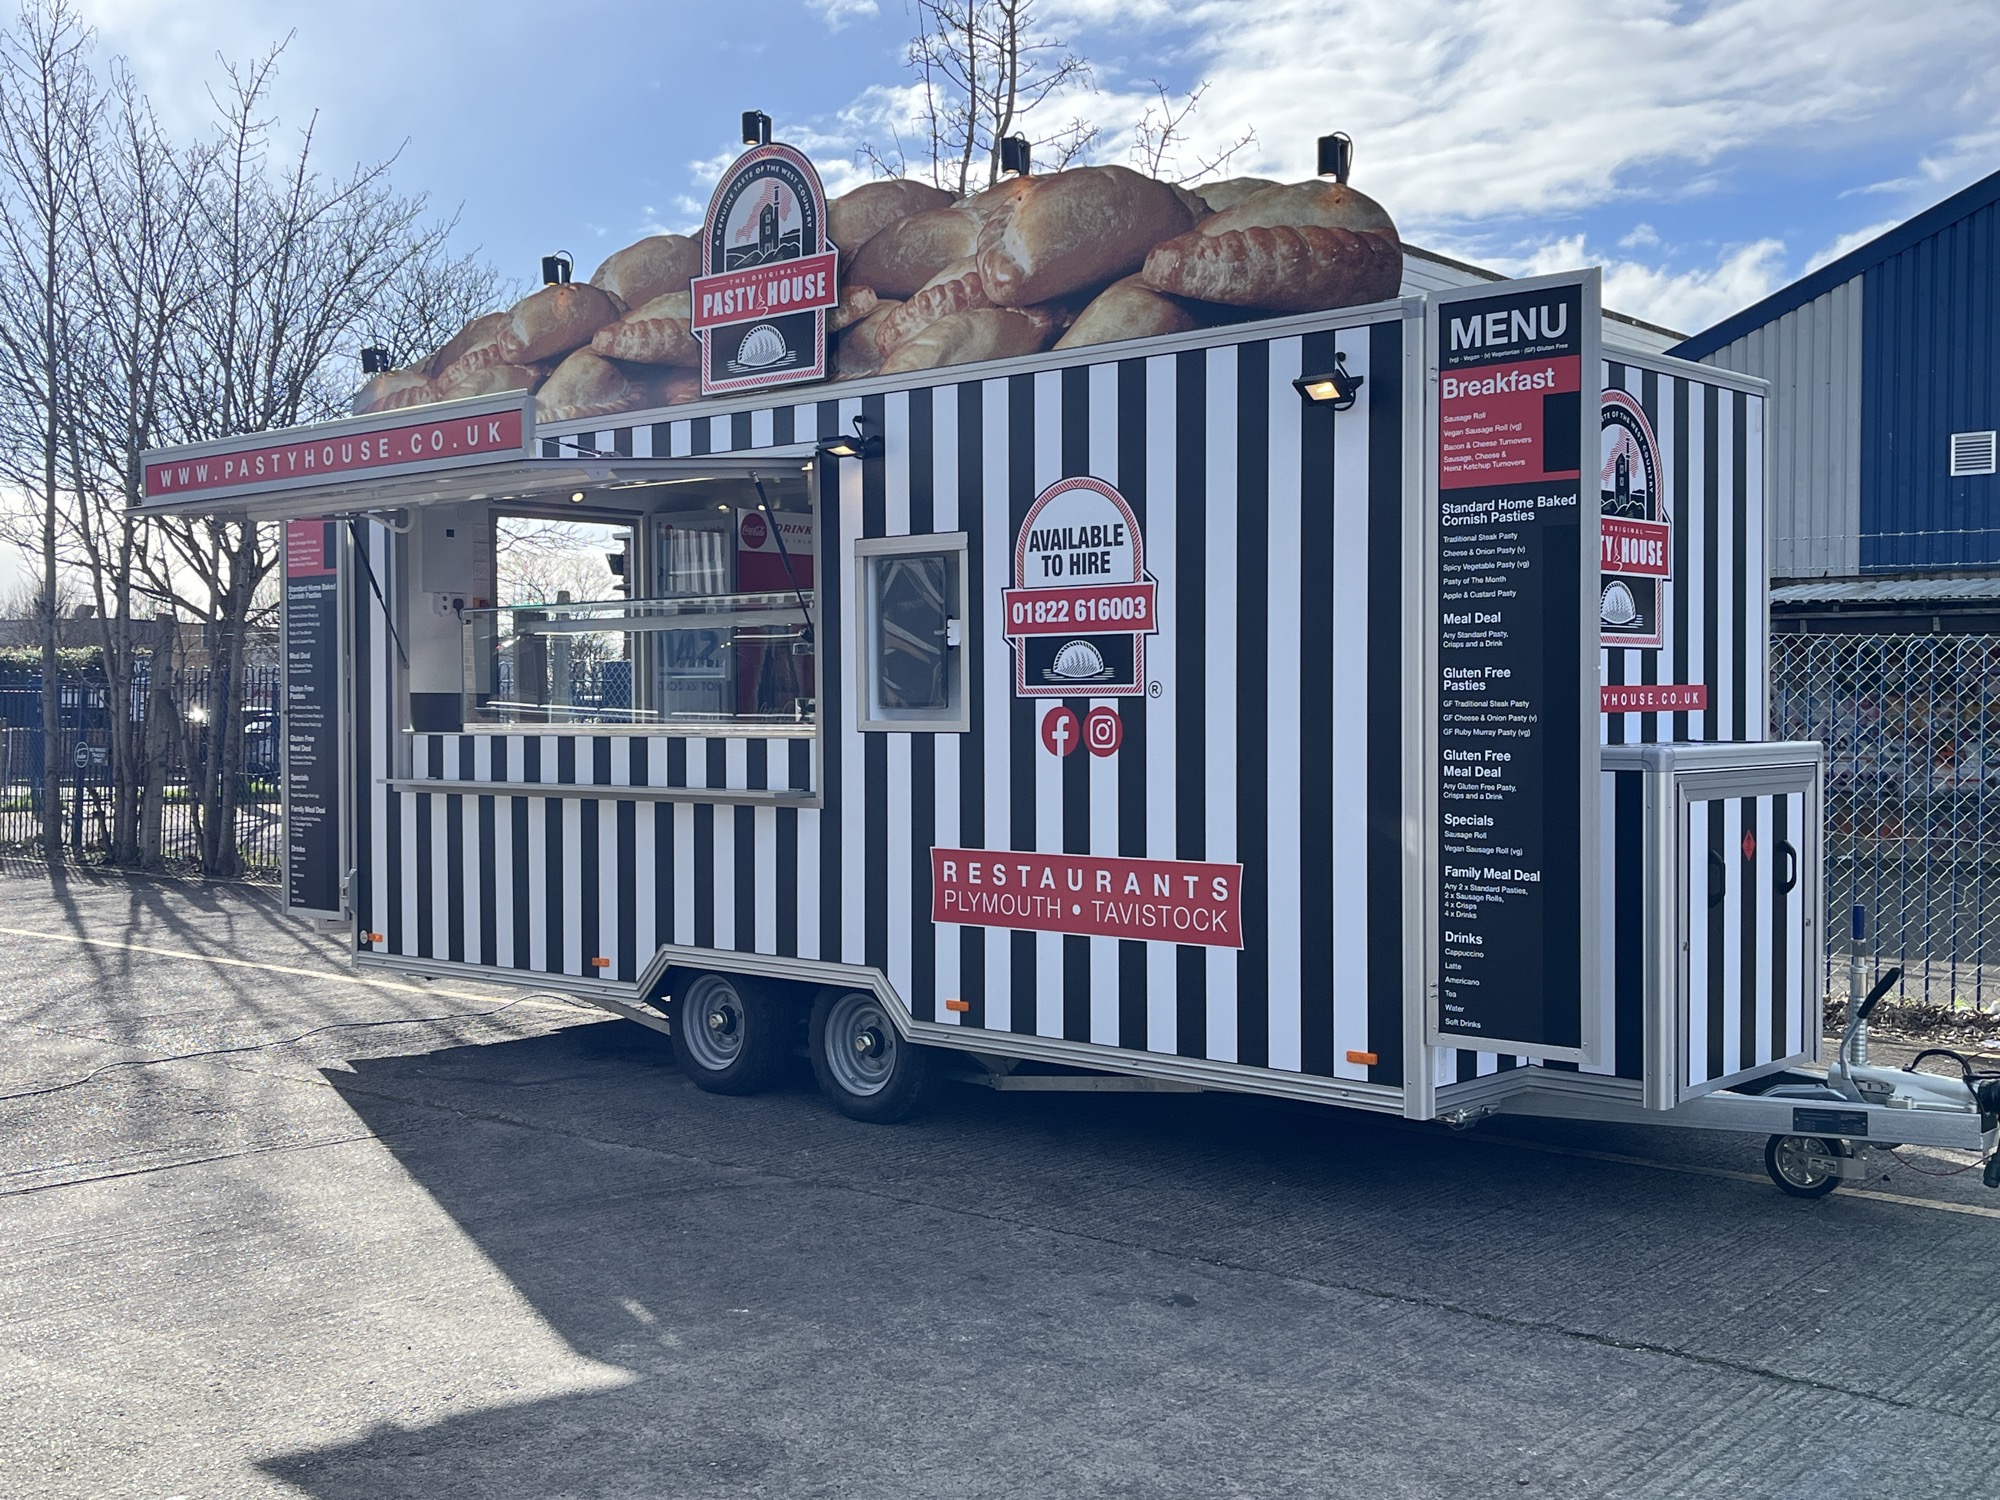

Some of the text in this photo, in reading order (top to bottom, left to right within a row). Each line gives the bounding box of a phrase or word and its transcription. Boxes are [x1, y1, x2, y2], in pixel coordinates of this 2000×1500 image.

[717, 192, 734, 235] GENUINE
[734, 172, 753, 192] TASTE
[781, 167, 798, 184] WEST
[798, 184, 812, 228] COUNTRY
[730, 267, 797, 285] THE ORIGINAL
[703, 272, 825, 318] PASTY HOUSE
[1450, 303, 1567, 351] MENU
[1443, 367, 1555, 399] Breakfast
[1443, 414, 1471, 423] Sausage
[1443, 423, 1522, 437] Vegan Sausage Roll (vg)
[1444, 442, 1464, 451] Bacon
[1472, 440, 1497, 448] Cheese
[1499, 437, 1532, 445] Turnovers
[160, 421, 502, 488] WWW.PASTYHOUSE.CO.UK
[1444, 455, 1473, 463] Sausage,
[1475, 452, 1500, 460] Cheese
[1463, 462, 1491, 470] Ketchup
[1492, 459, 1526, 468] Turnovers
[1442, 494, 1577, 514] Standard Home Baked
[1442, 510, 1535, 526] Cornish Pasties
[1609, 525, 1643, 534] ORIGINAL
[1028, 524, 1123, 552] AVAILABLE
[1443, 532, 1518, 543] Traditional Steak Pasty
[1443, 549, 1467, 557] Cheese
[1476, 547, 1495, 556] Onion
[1497, 547, 1516, 555] Pasty
[1517, 546, 1525, 554] (v)
[1621, 537, 1662, 566] HOUSE
[1042, 551, 1111, 577] TO HIRE
[1443, 560, 1529, 572] Spicy Vegetable Pasty (vg)
[1443, 578, 1461, 586] Pasty
[1443, 592, 1462, 600] Apple
[1470, 590, 1496, 598] Custard
[1497, 589, 1516, 598] Pasty
[1012, 596, 1147, 624] 01822 616003
[1443, 612, 1501, 624] Meal Deal
[1443, 632, 1456, 640] Any
[1488, 630, 1508, 638] Pasty,
[1443, 641, 1464, 649] Crisps
[1443, 667, 1511, 678] Gluten Free
[1444, 680, 1486, 691] Pasties
[1510, 700, 1529, 708] Pasty
[1602, 692, 1698, 706] YHOUSE.CO.UK
[1508, 714, 1527, 723] Pasty
[1529, 714, 1537, 722] (v)
[1454, 728, 1472, 737] Ruby
[1473, 729, 1496, 737] Murray
[1497, 729, 1516, 737] Pasty
[1518, 729, 1531, 737] (vg)
[1443, 749, 1511, 761] Gluten Free
[1443, 765, 1501, 778] Meal Deal
[1443, 783, 1456, 791] Any
[1496, 784, 1517, 792] Pasty,
[1443, 792, 1464, 800] Crisps
[1444, 813, 1494, 827] Specials
[1444, 831, 1472, 839] Sausage
[1444, 845, 1464, 853] Vegan
[1466, 845, 1494, 854] Sausage
[1510, 848, 1523, 856] (vg)
[1445, 866, 1540, 881] Family Meal Deal
[943, 860, 1229, 902] RESTAURANTS
[1444, 883, 1457, 891] Any
[1470, 884, 1500, 892] Standard
[1501, 886, 1528, 895] Pasties,
[1456, 893, 1484, 902] Sausage
[1486, 895, 1504, 903] Rolls,
[944, 890, 1228, 933] PLYMOUTH TAVISTOCK
[1456, 902, 1477, 910] Crisps
[1456, 911, 1477, 919] Drinks
[1445, 931, 1483, 944] Drinks
[1445, 948, 1484, 958] Cappuccino
[1445, 962, 1462, 970] Latte
[1445, 976, 1480, 986] Americano
[1445, 990, 1457, 998] Tea
[1445, 1004, 1464, 1012] Water
[1445, 1018, 1481, 1028] Soft Drinks
